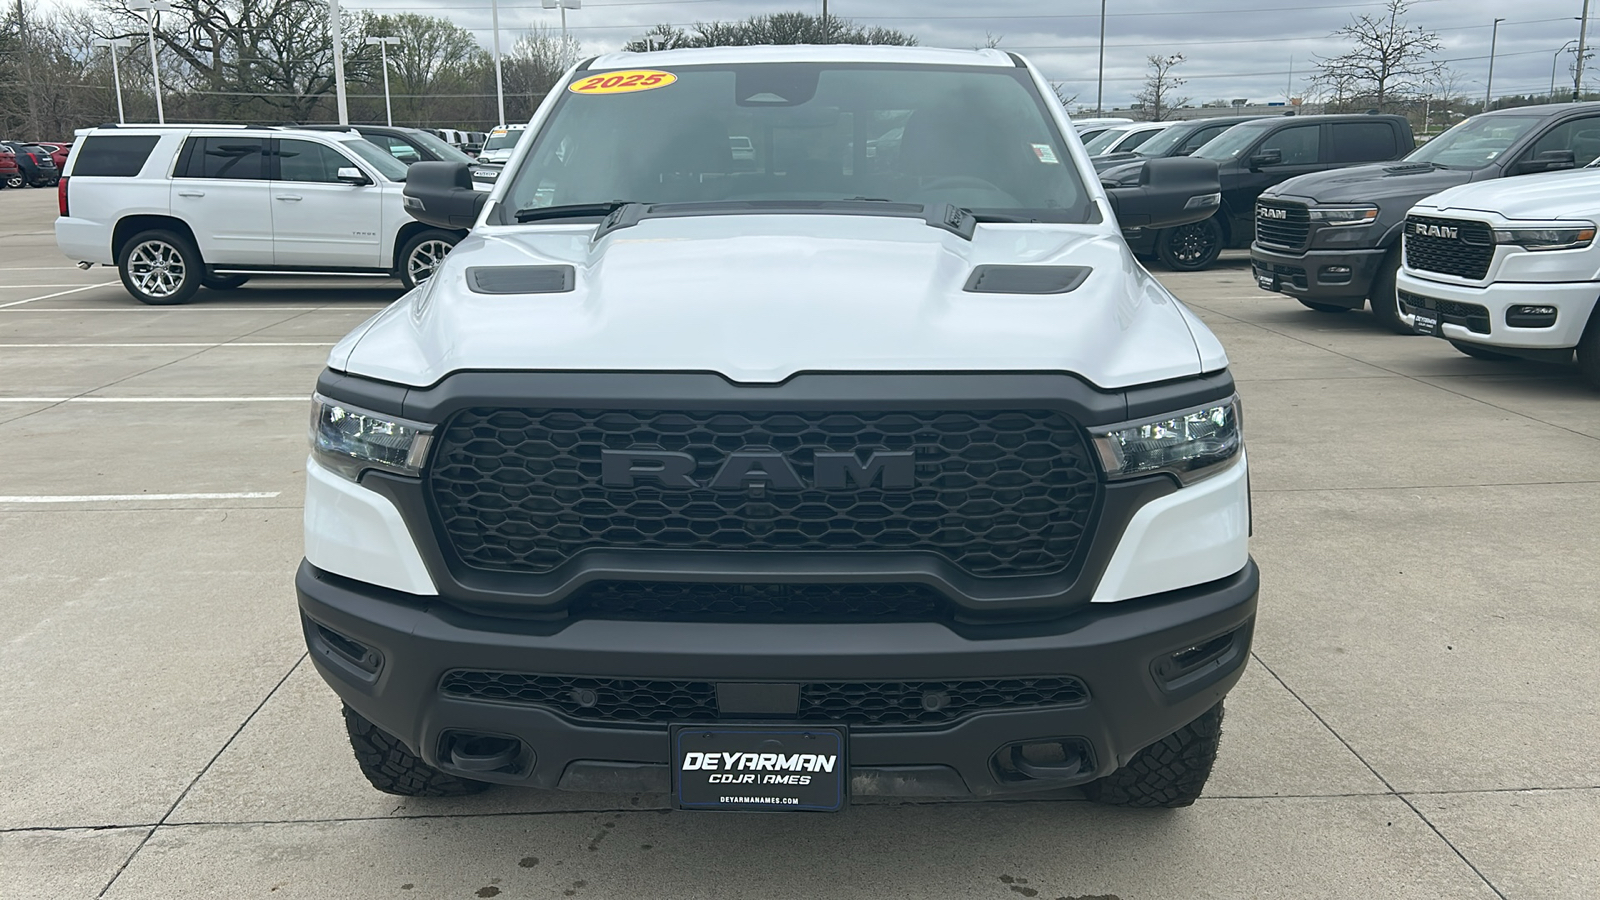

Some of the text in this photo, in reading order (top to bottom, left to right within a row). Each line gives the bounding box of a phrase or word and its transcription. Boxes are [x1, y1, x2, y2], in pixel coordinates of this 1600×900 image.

[578, 73, 668, 91] 2025
[1260, 207, 1287, 219] RAM
[1415, 223, 1458, 239] RAM
[601, 449, 915, 489] RAM
[682, 752, 837, 773] DEYARMAN
[762, 774, 812, 785] AMES
[720, 796, 799, 805] DEYARMANAMES.COM
